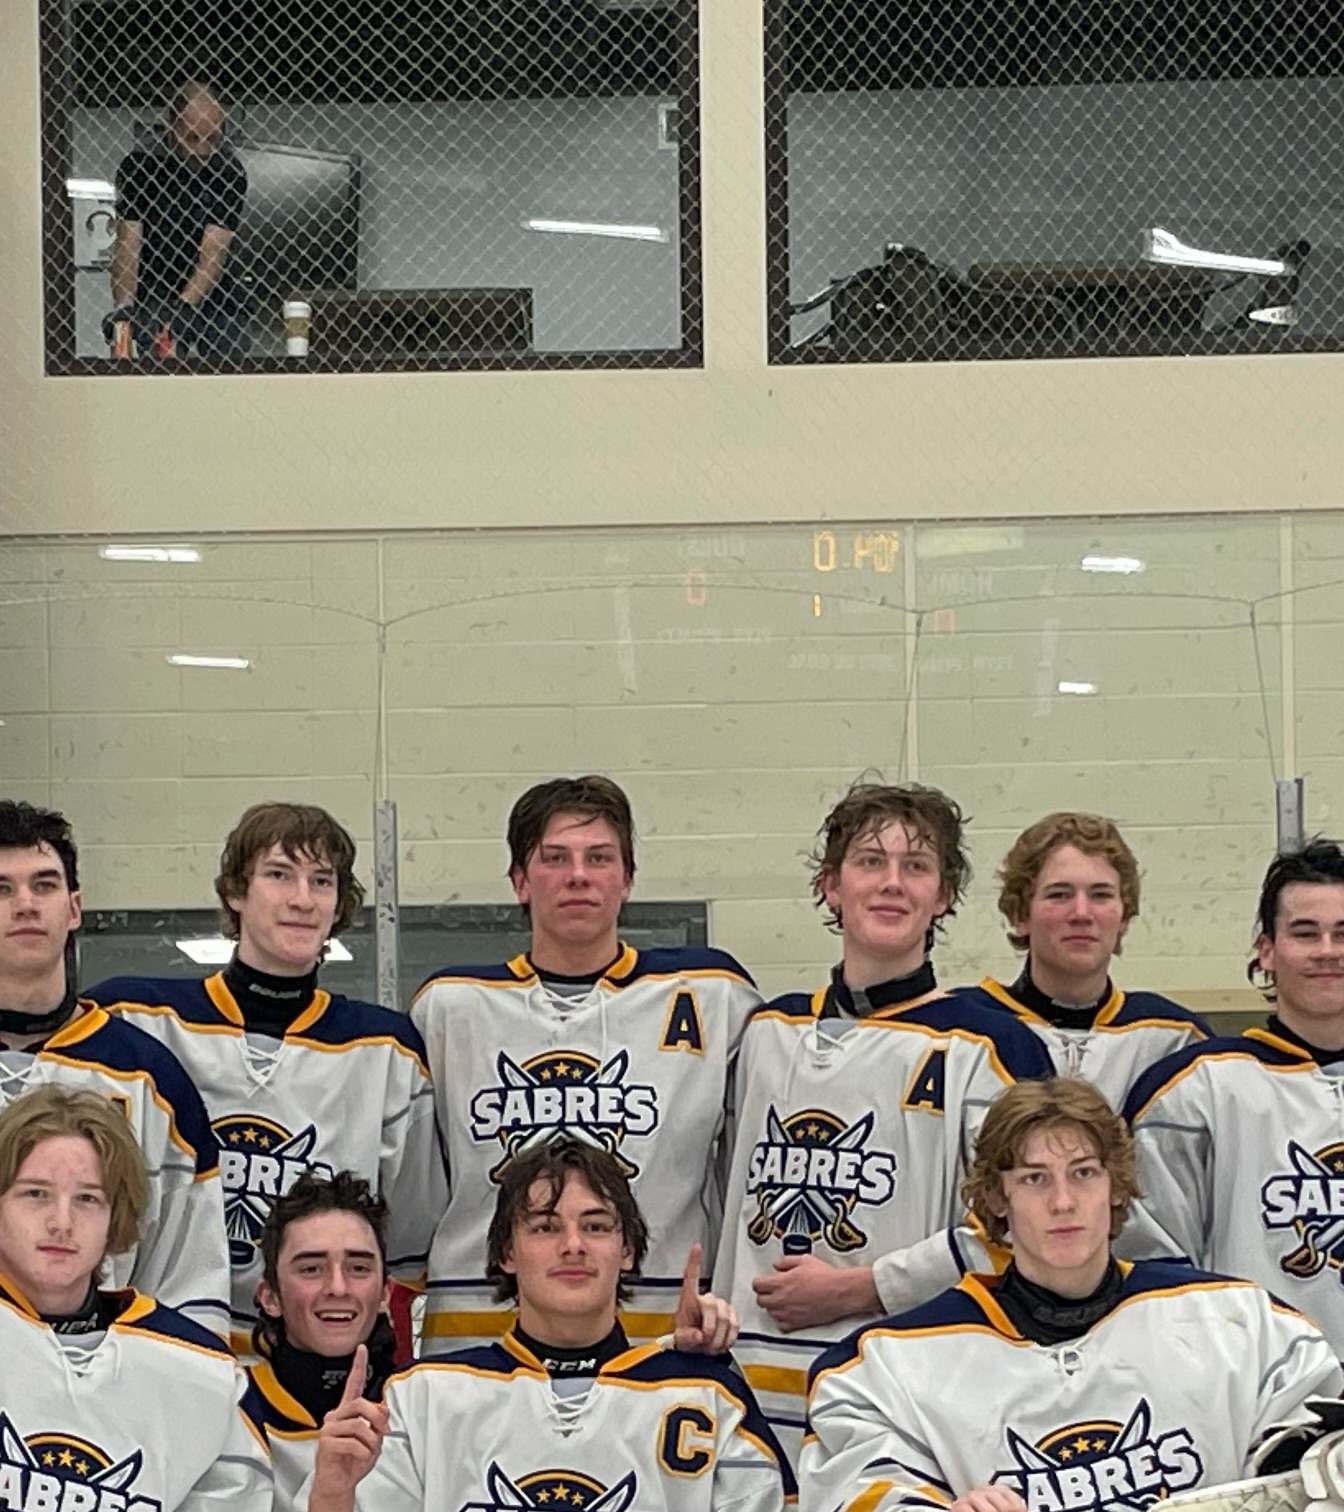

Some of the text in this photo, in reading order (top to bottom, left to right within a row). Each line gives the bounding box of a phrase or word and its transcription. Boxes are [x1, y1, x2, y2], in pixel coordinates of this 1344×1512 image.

[661, 988, 704, 1055] A
[471, 1086, 658, 1139] SABRES
[903, 1049, 946, 1114] A
[747, 1145, 896, 1204] SABRES
[659, 1403, 716, 1477] C
